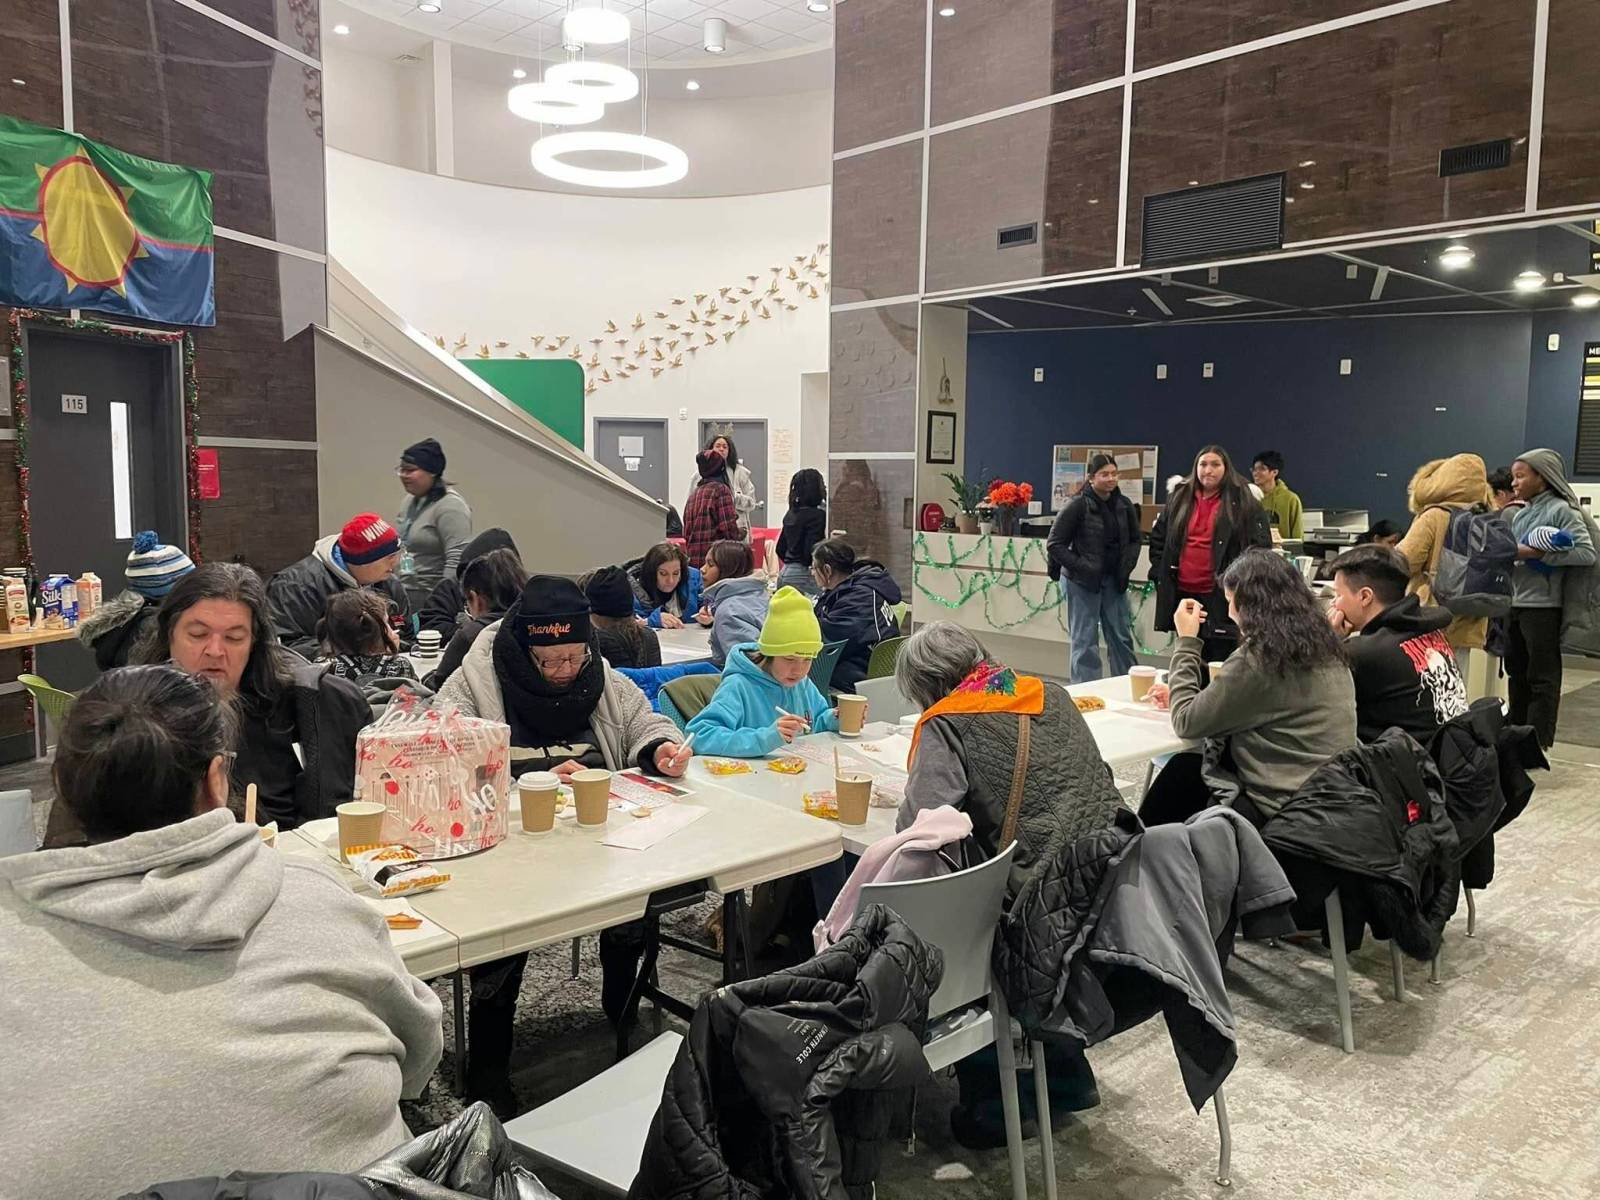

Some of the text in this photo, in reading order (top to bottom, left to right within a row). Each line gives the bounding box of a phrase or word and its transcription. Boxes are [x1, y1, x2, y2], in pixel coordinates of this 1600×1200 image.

[66, 398, 83, 410] 115
[42, 589, 63, 605] Silk
[527, 622, 571, 638] Thankful
[410, 815, 434, 834] ho
[795, 1046, 812, 1064] COLE
